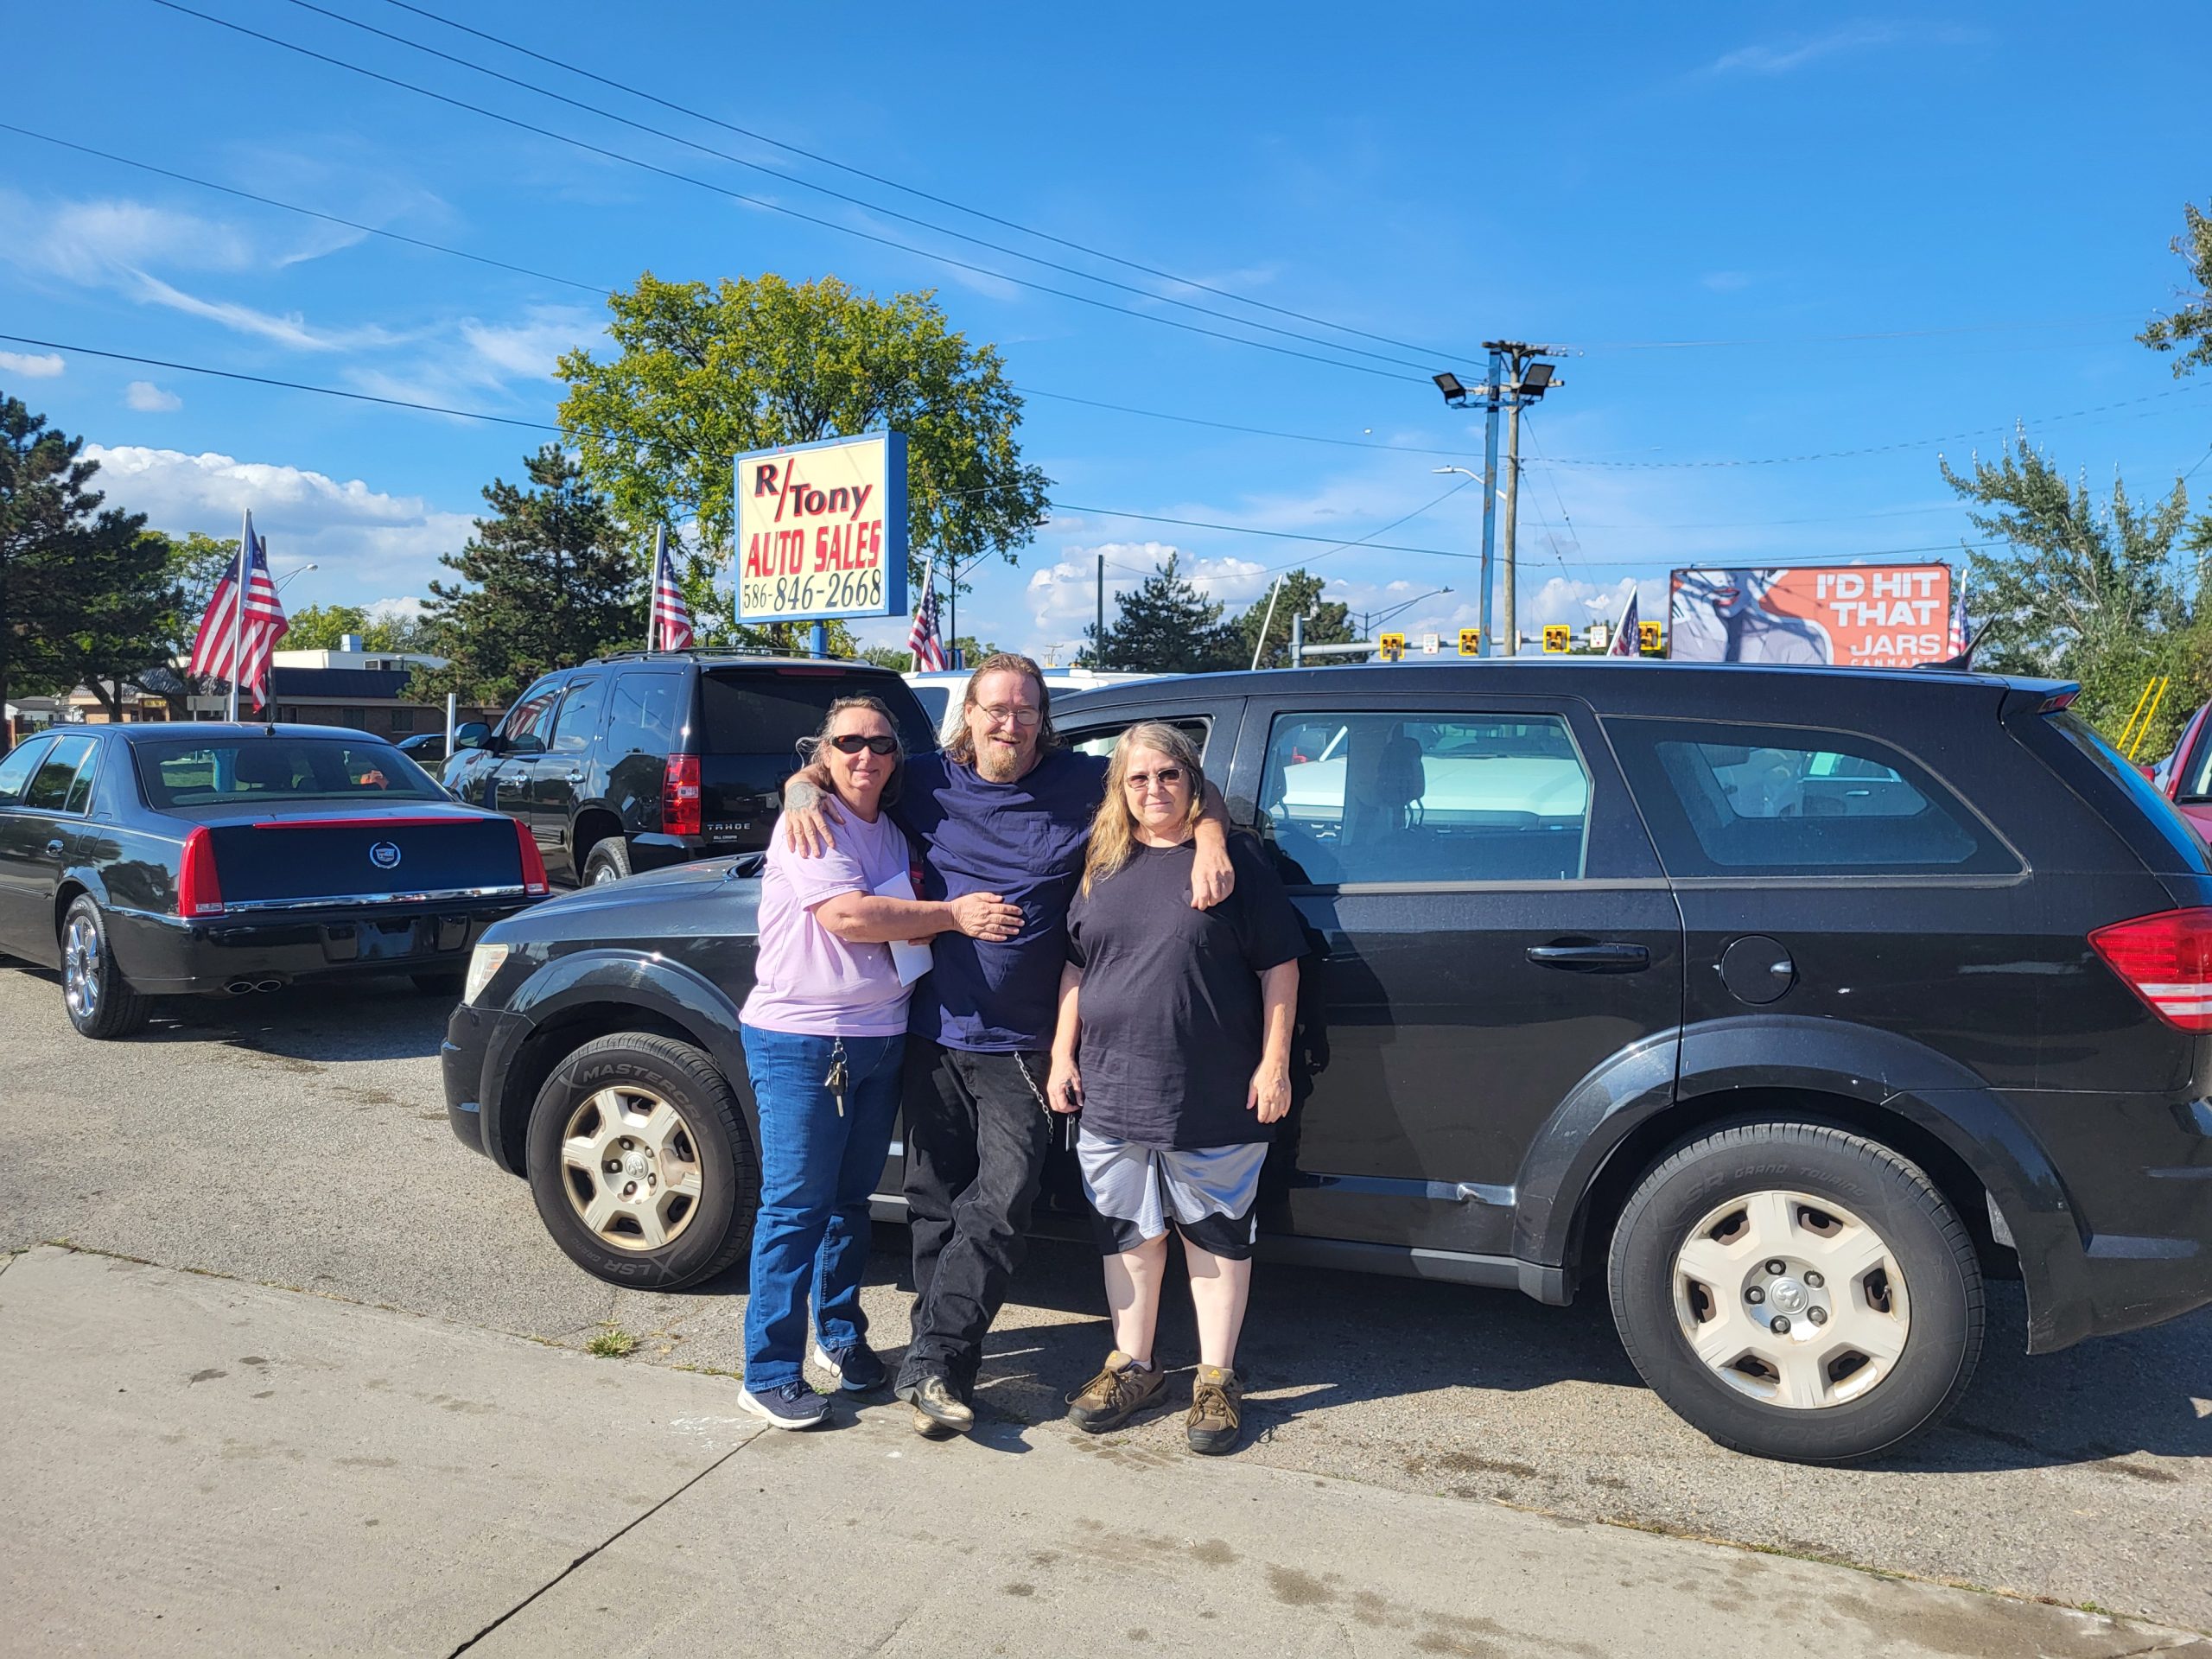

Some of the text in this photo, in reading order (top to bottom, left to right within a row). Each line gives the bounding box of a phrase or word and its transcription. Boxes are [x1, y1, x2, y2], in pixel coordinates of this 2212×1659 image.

[745, 519, 882, 578] AUTO SALES
[744, 569, 880, 611] 586-846-2668
[1816, 571, 1941, 600] I'D HIT
[1829, 601, 1941, 627] THAT
[1850, 634, 1941, 657] JARS
